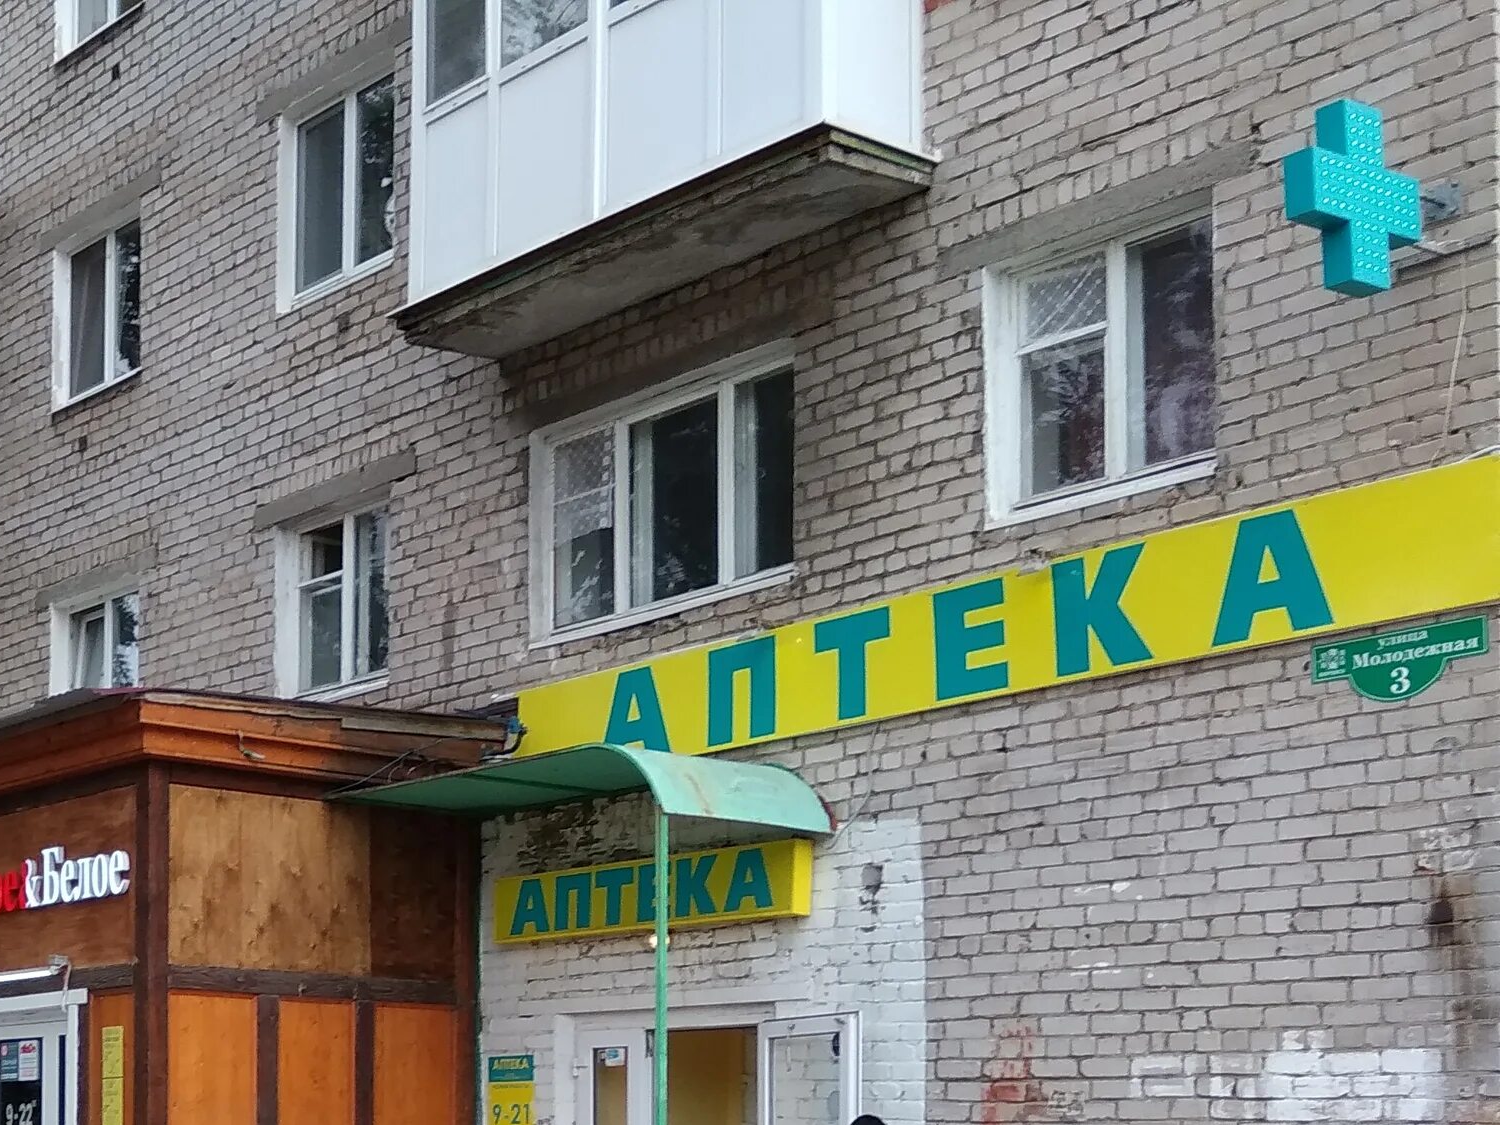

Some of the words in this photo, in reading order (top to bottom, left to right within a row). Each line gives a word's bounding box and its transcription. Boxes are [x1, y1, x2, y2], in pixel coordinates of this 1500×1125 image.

[603, 508, 1335, 752] АПТЕКА
[1377, 630, 1428, 650] улица
[1351, 636, 1480, 669] Молодежная
[1389, 666, 1412, 694] 3
[509, 847, 775, 936] АПТЕКА
